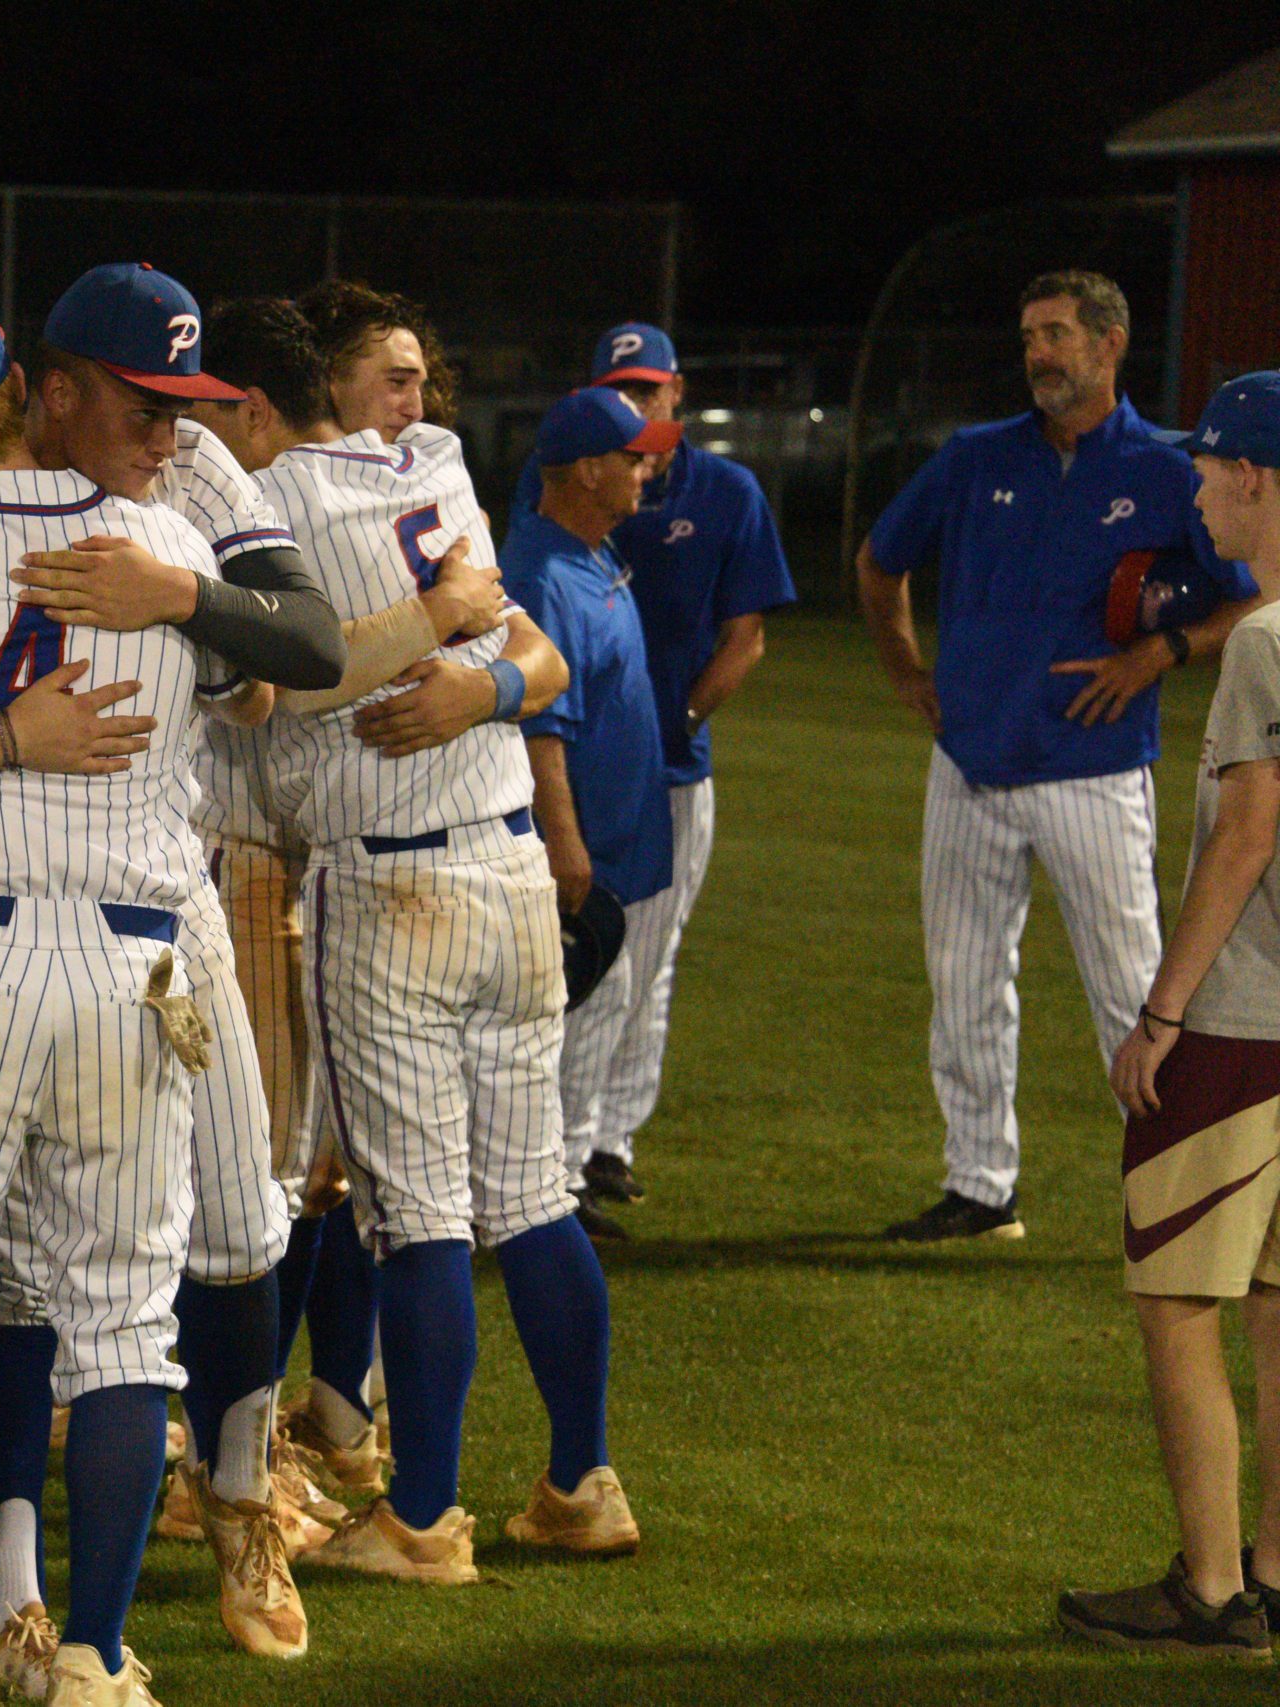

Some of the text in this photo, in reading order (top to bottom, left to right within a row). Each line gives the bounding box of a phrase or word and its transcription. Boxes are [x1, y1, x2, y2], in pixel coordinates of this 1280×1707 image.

[166, 313, 200, 364] P
[611, 333, 643, 365] P
[1102, 498, 1136, 525] P
[663, 519, 694, 544] P
